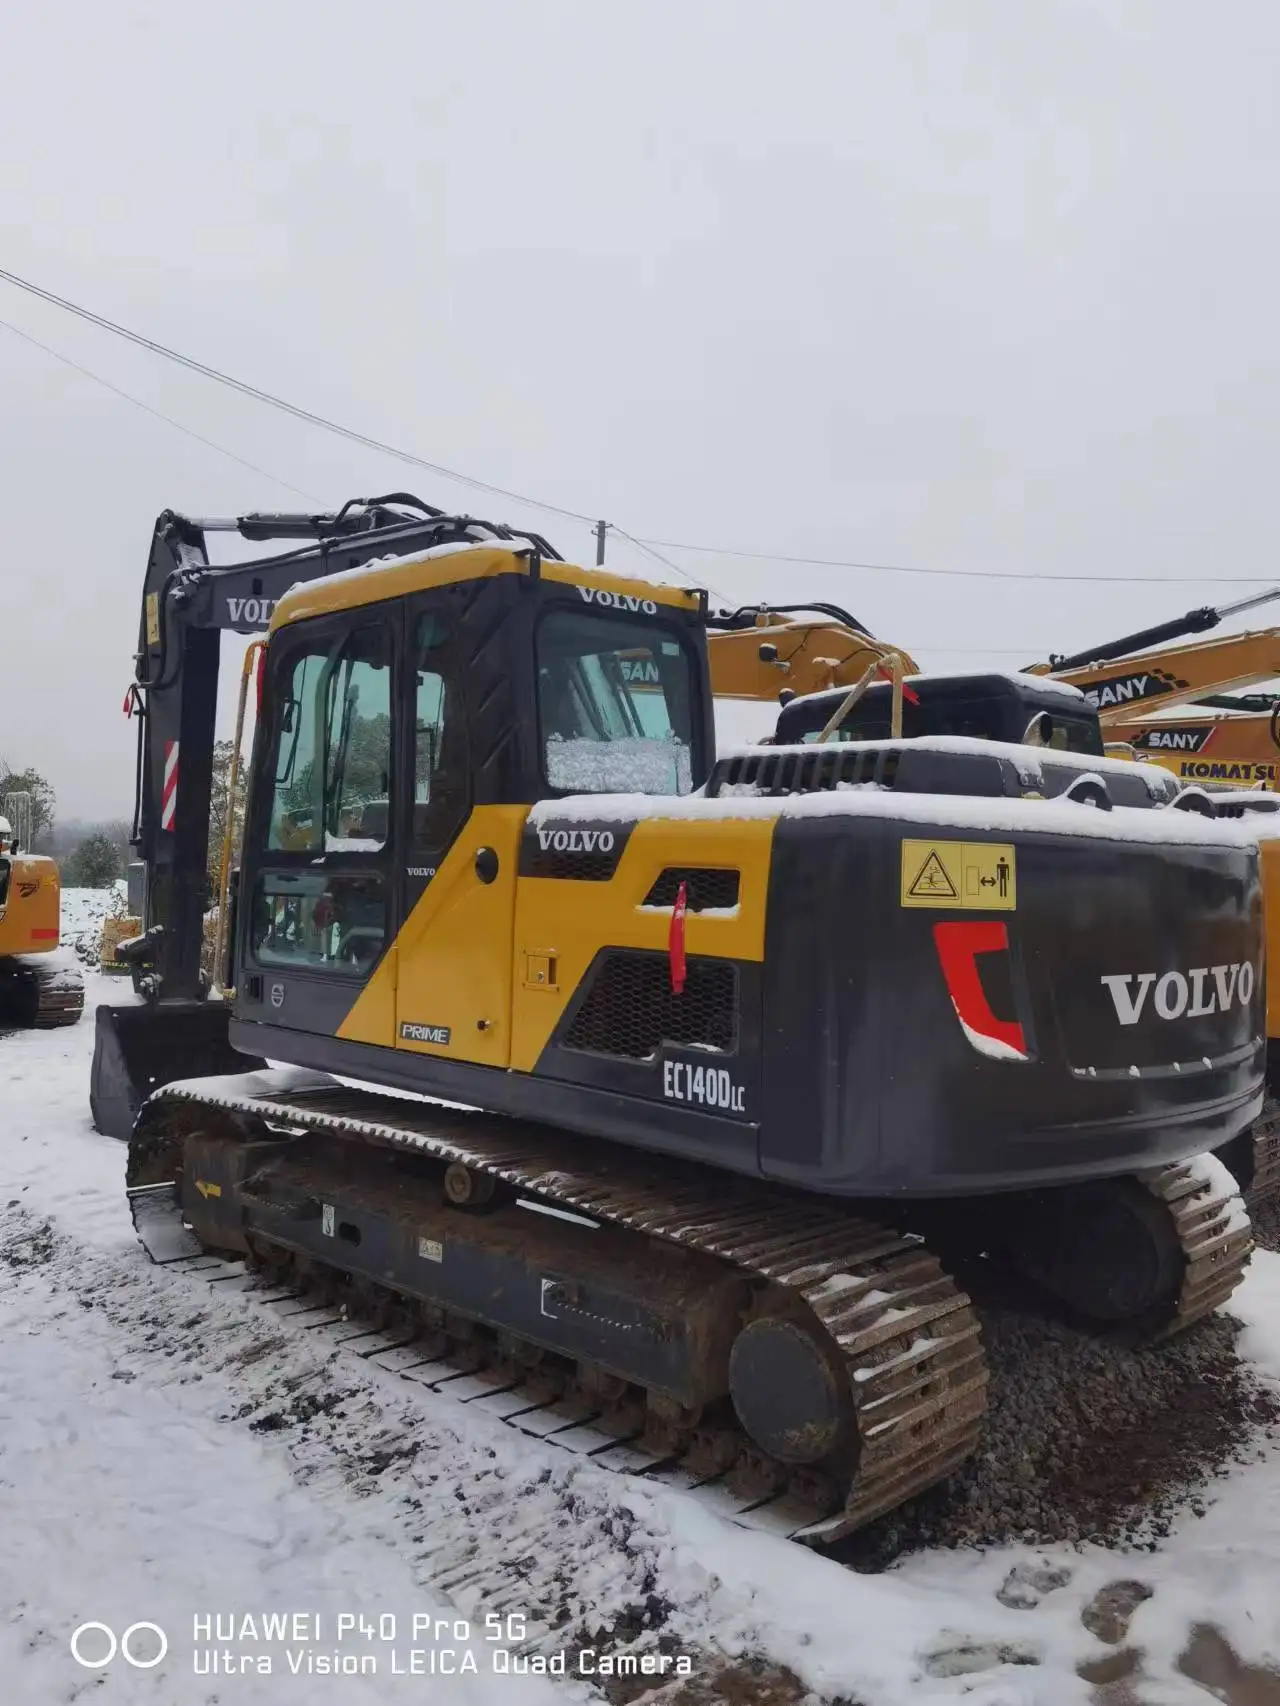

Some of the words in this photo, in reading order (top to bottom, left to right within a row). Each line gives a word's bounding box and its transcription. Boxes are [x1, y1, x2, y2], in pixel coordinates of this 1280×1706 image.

[226, 598, 278, 623] VOL
[575, 585, 657, 615] VOLVO
[1083, 676, 1148, 708] SANY
[1148, 732, 1199, 749] SANY
[538, 830, 614, 852] VOLVO
[407, 867, 435, 876] VOLVO
[1101, 961, 1254, 1025] VOLVO
[402, 1024, 449, 1043] PRIME
